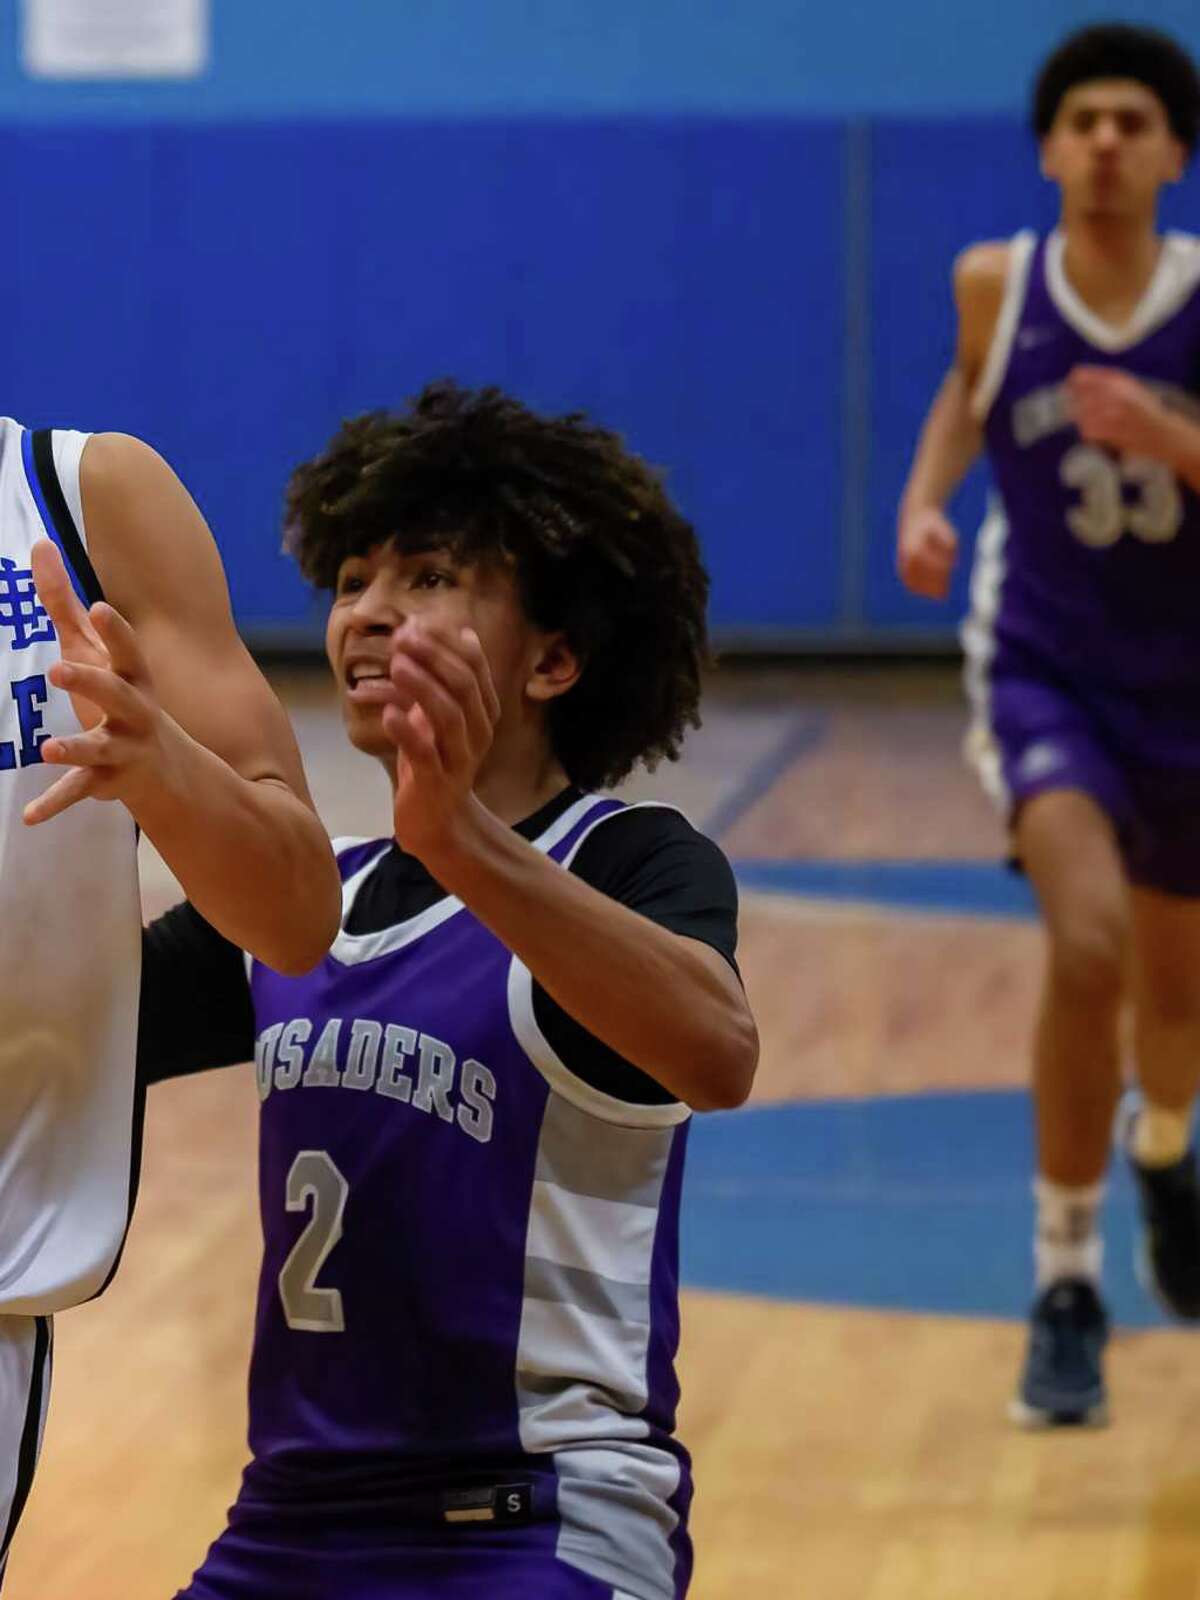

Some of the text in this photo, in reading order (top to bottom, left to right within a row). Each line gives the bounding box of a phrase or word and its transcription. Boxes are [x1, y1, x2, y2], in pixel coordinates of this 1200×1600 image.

[1059, 446, 1184, 547] 33
[278, 1150, 350, 1333] 2
[507, 1493, 521, 1512] S
